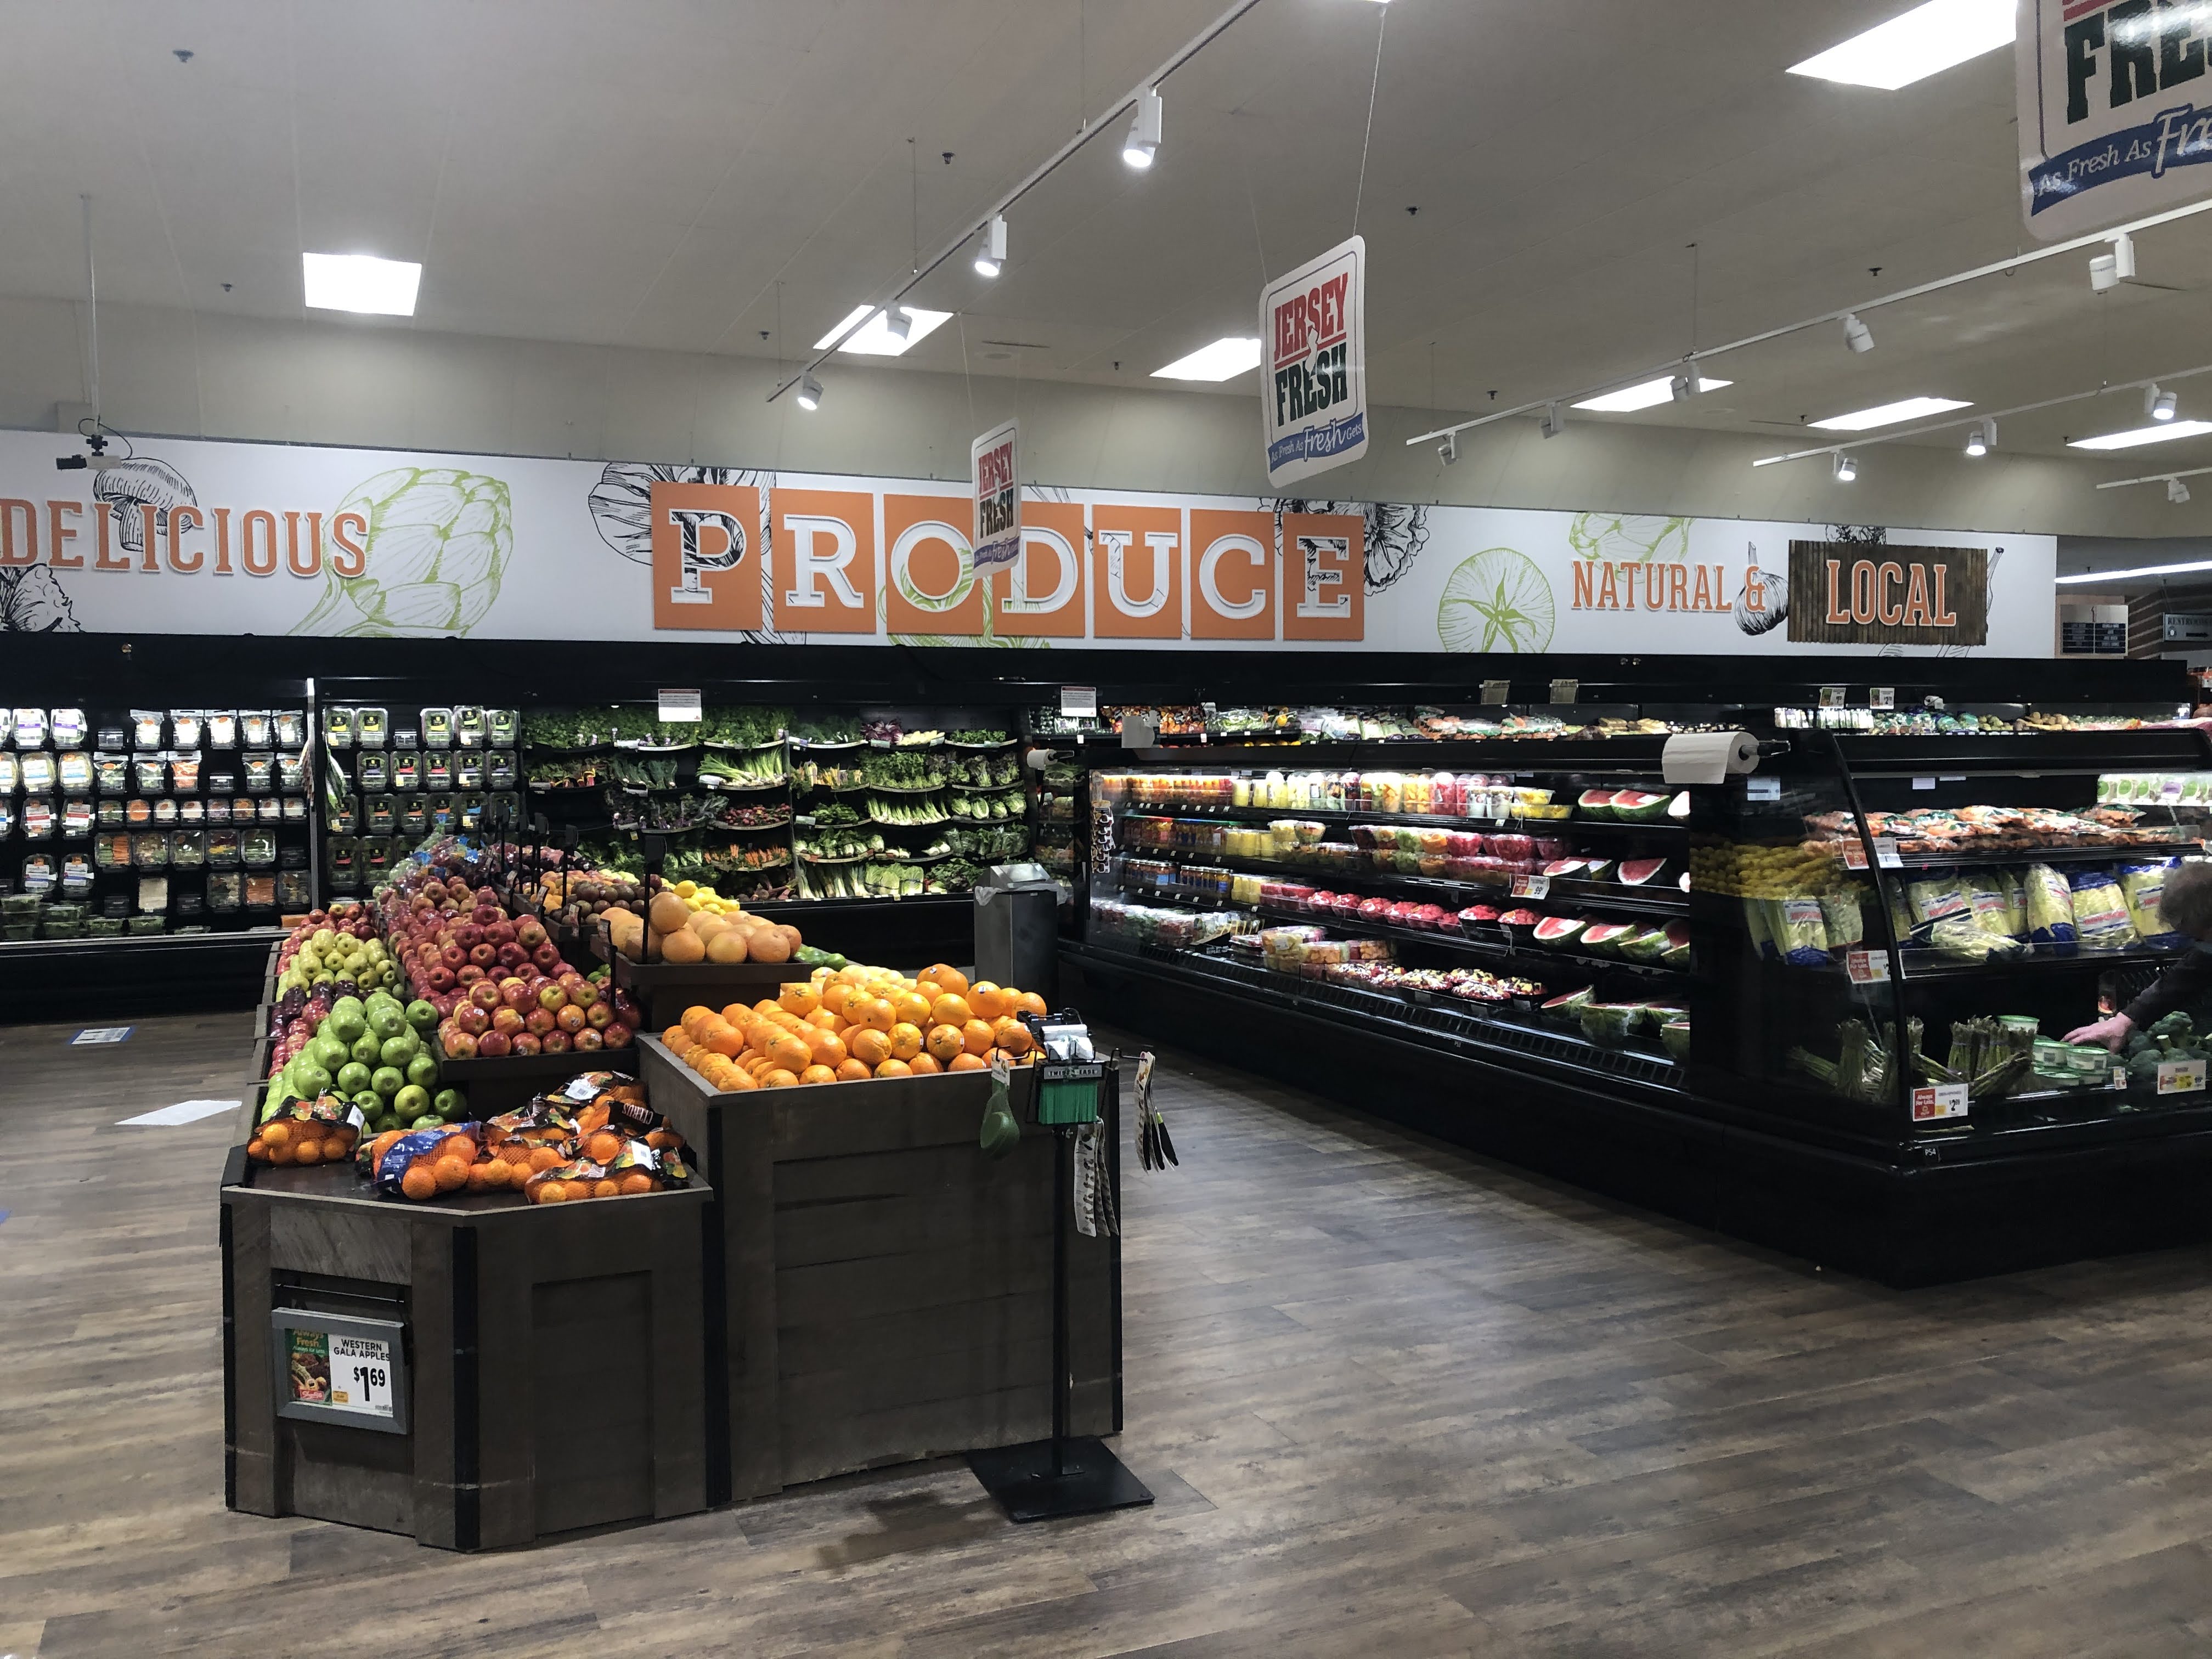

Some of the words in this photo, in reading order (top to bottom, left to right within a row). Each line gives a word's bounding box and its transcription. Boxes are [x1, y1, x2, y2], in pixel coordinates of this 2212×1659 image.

[2064, 0, 2212, 125] FRE
[2067, 144, 2120, 182] Fresh
[2124, 140, 2152, 162] As
[1274, 272, 1348, 362] JERSEY
[1275, 342, 1348, 427] FRESH
[979, 441, 1013, 494] JERSEY
[1271, 451, 1278, 464] As
[1279, 441, 1295, 459] Fresh
[1296, 439, 1304, 452] As
[1304, 420, 1346, 460] Fresh
[1346, 423, 1362, 439] Gets
[0, 498, 369, 578] DELICIOUS
[979, 488, 1014, 539] FRESH
[668, 507, 1352, 619] PRODUCE
[1571, 560, 1732, 612] NATURAL
[1744, 566, 1767, 612] &
[1825, 558, 1957, 627] LOCAL
[622, 1103, 653, 1125] CITRUS
[333, 1346, 356, 1358] GALA
[359, 1350, 390, 1362] APPLES
[341, 1338, 382, 1352] WESTERN
